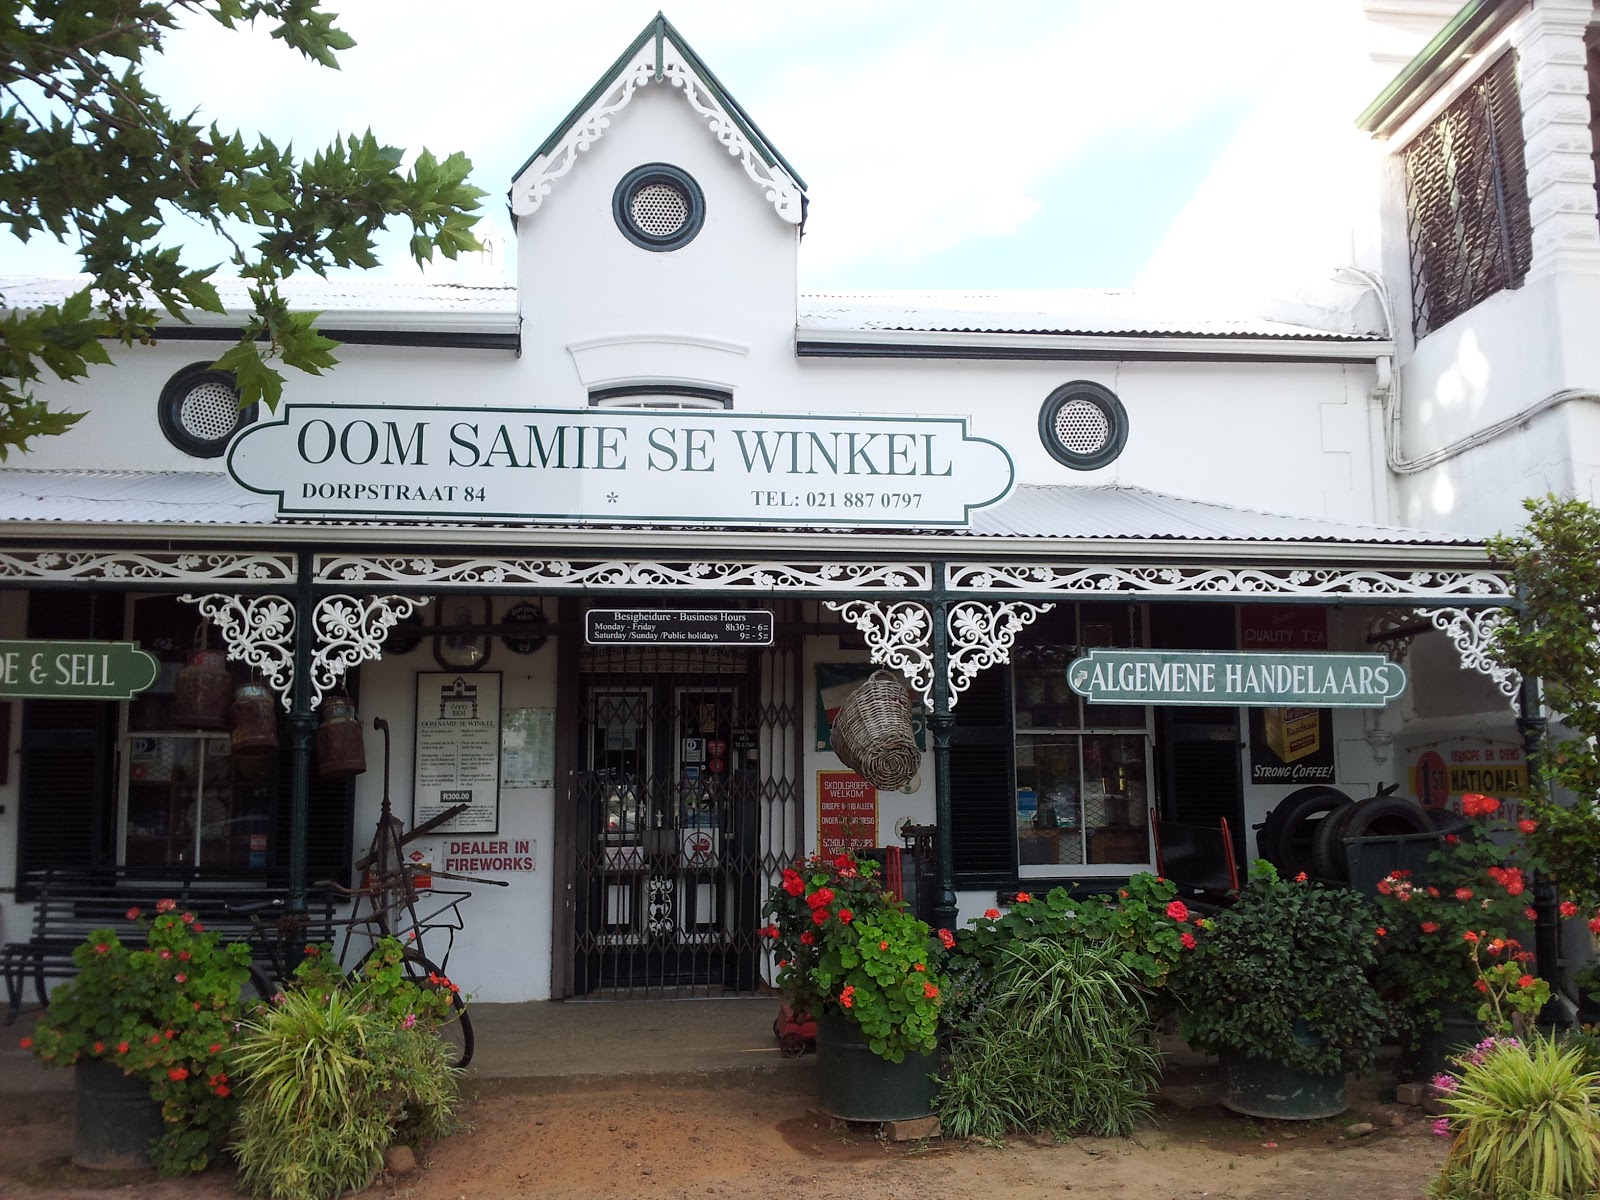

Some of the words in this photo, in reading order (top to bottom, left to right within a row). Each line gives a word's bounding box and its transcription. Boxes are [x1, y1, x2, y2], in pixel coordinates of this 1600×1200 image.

[297, 418, 431, 466] OOM
[448, 421, 627, 471] SAMIE
[647, 426, 715, 472] SE
[731, 429, 953, 477] WINKEL
[301, 482, 458, 502] DORPSTRAAT
[463, 486, 487, 503] 84
[750, 490, 800, 508] TEL:
[805, 491, 836, 508] 021
[842, 492, 875, 509] 887
[880, 493, 922, 509] 0797
[614, 612, 671, 623] Besigheidure
[679, 612, 718, 622] Business
[720, 612, 747, 622] Hours
[594, 622, 625, 632] Monday
[632, 622, 657, 632] Friday
[594, 631, 627, 641] Saturday
[687, 632, 718, 641] holidays
[1245, 628, 1294, 642] QUALITY
[1301, 629, 1325, 642] TEA
[29, 652, 48, 684] &
[55, 653, 115, 686] SELL
[1088, 662, 1216, 693] ALGEMENE
[1225, 663, 1391, 695] HANDELAARS
[1286, 718, 1317, 737] Raadsaal
[1254, 764, 1292, 778] STRONG
[1292, 763, 1334, 778] COFFEE!
[825, 782, 869, 790] SKOOLGROEPE
[442, 792, 470, 801] R300.00
[831, 790, 864, 798] WELKOM
[822, 817, 838, 825] ONDER
[450, 841, 508, 855] DEALER
[515, 841, 529, 854] IN
[823, 838, 848, 847] SCHOLA
[446, 857, 534, 871] FIREWORKS
